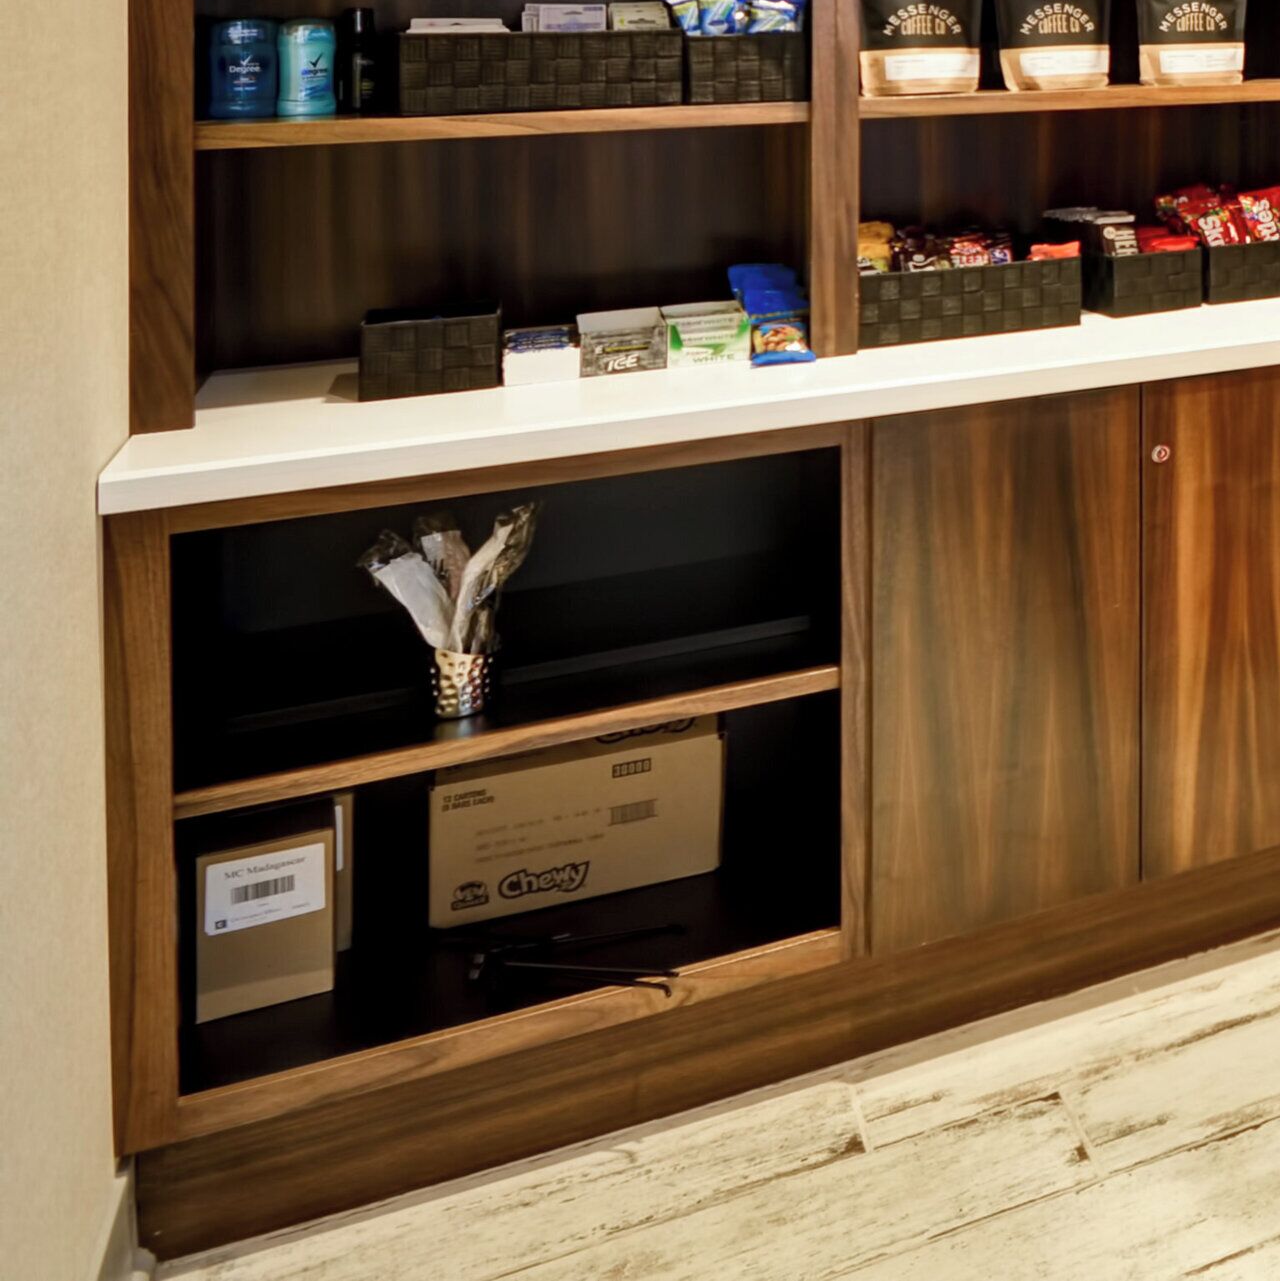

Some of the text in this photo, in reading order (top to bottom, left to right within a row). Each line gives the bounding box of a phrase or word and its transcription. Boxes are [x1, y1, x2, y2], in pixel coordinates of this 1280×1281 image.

[882, 2, 963, 37] MESSENGER
[901, 15, 933, 36] COFFEE
[1020, 1, 1095, 36] MESSENGER
[1038, 14, 1069, 34] COFFEE
[1158, 1, 1228, 33] MESSENGER
[1177, 12, 1205, 32] COFFEE
[229, 65, 261, 74] Degree
[606, 353, 640, 372] ICE
[692, 353, 735, 363] WHITE
[225, 857, 306, 879] MC Madagascar
[499, 861, 590, 899] Chewy
